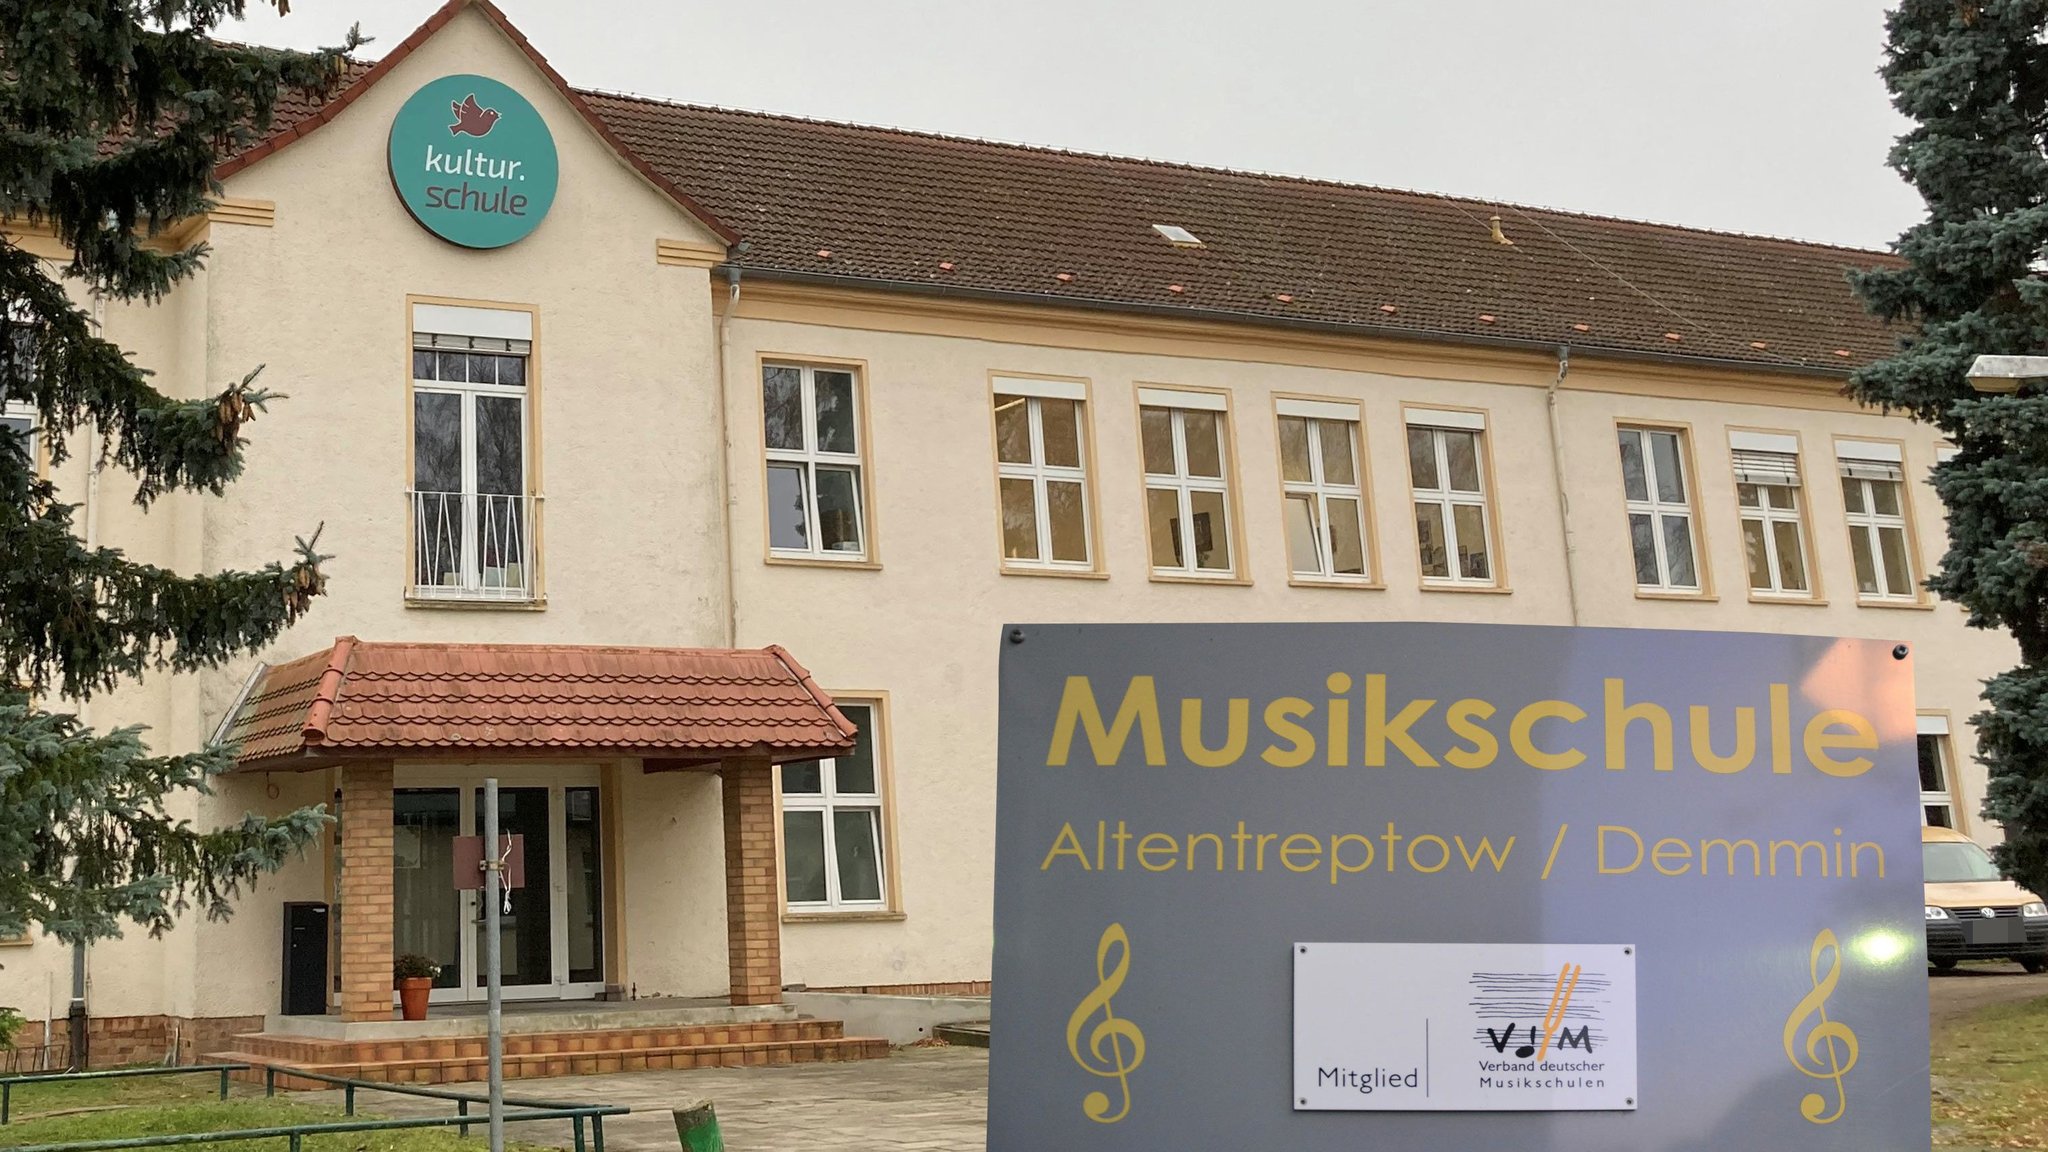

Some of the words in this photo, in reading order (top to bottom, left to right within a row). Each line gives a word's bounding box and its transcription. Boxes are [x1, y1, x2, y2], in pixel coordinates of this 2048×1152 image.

[425, 144, 525, 181] kultur.
[425, 181, 528, 216] schule
[1046, 671, 1881, 778] Musikschule
[1041, 821, 1517, 885] Altentreptow
[1541, 823, 1569, 881] /
[1598, 824, 1887, 879] Demmin
[1317, 1066, 1418, 1094] Mitglied
[1479, 1060, 1535, 1072] Verband
[1539, 1060, 1605, 1072] deutscher
[1479, 1076, 1605, 1089] Musikschulen
